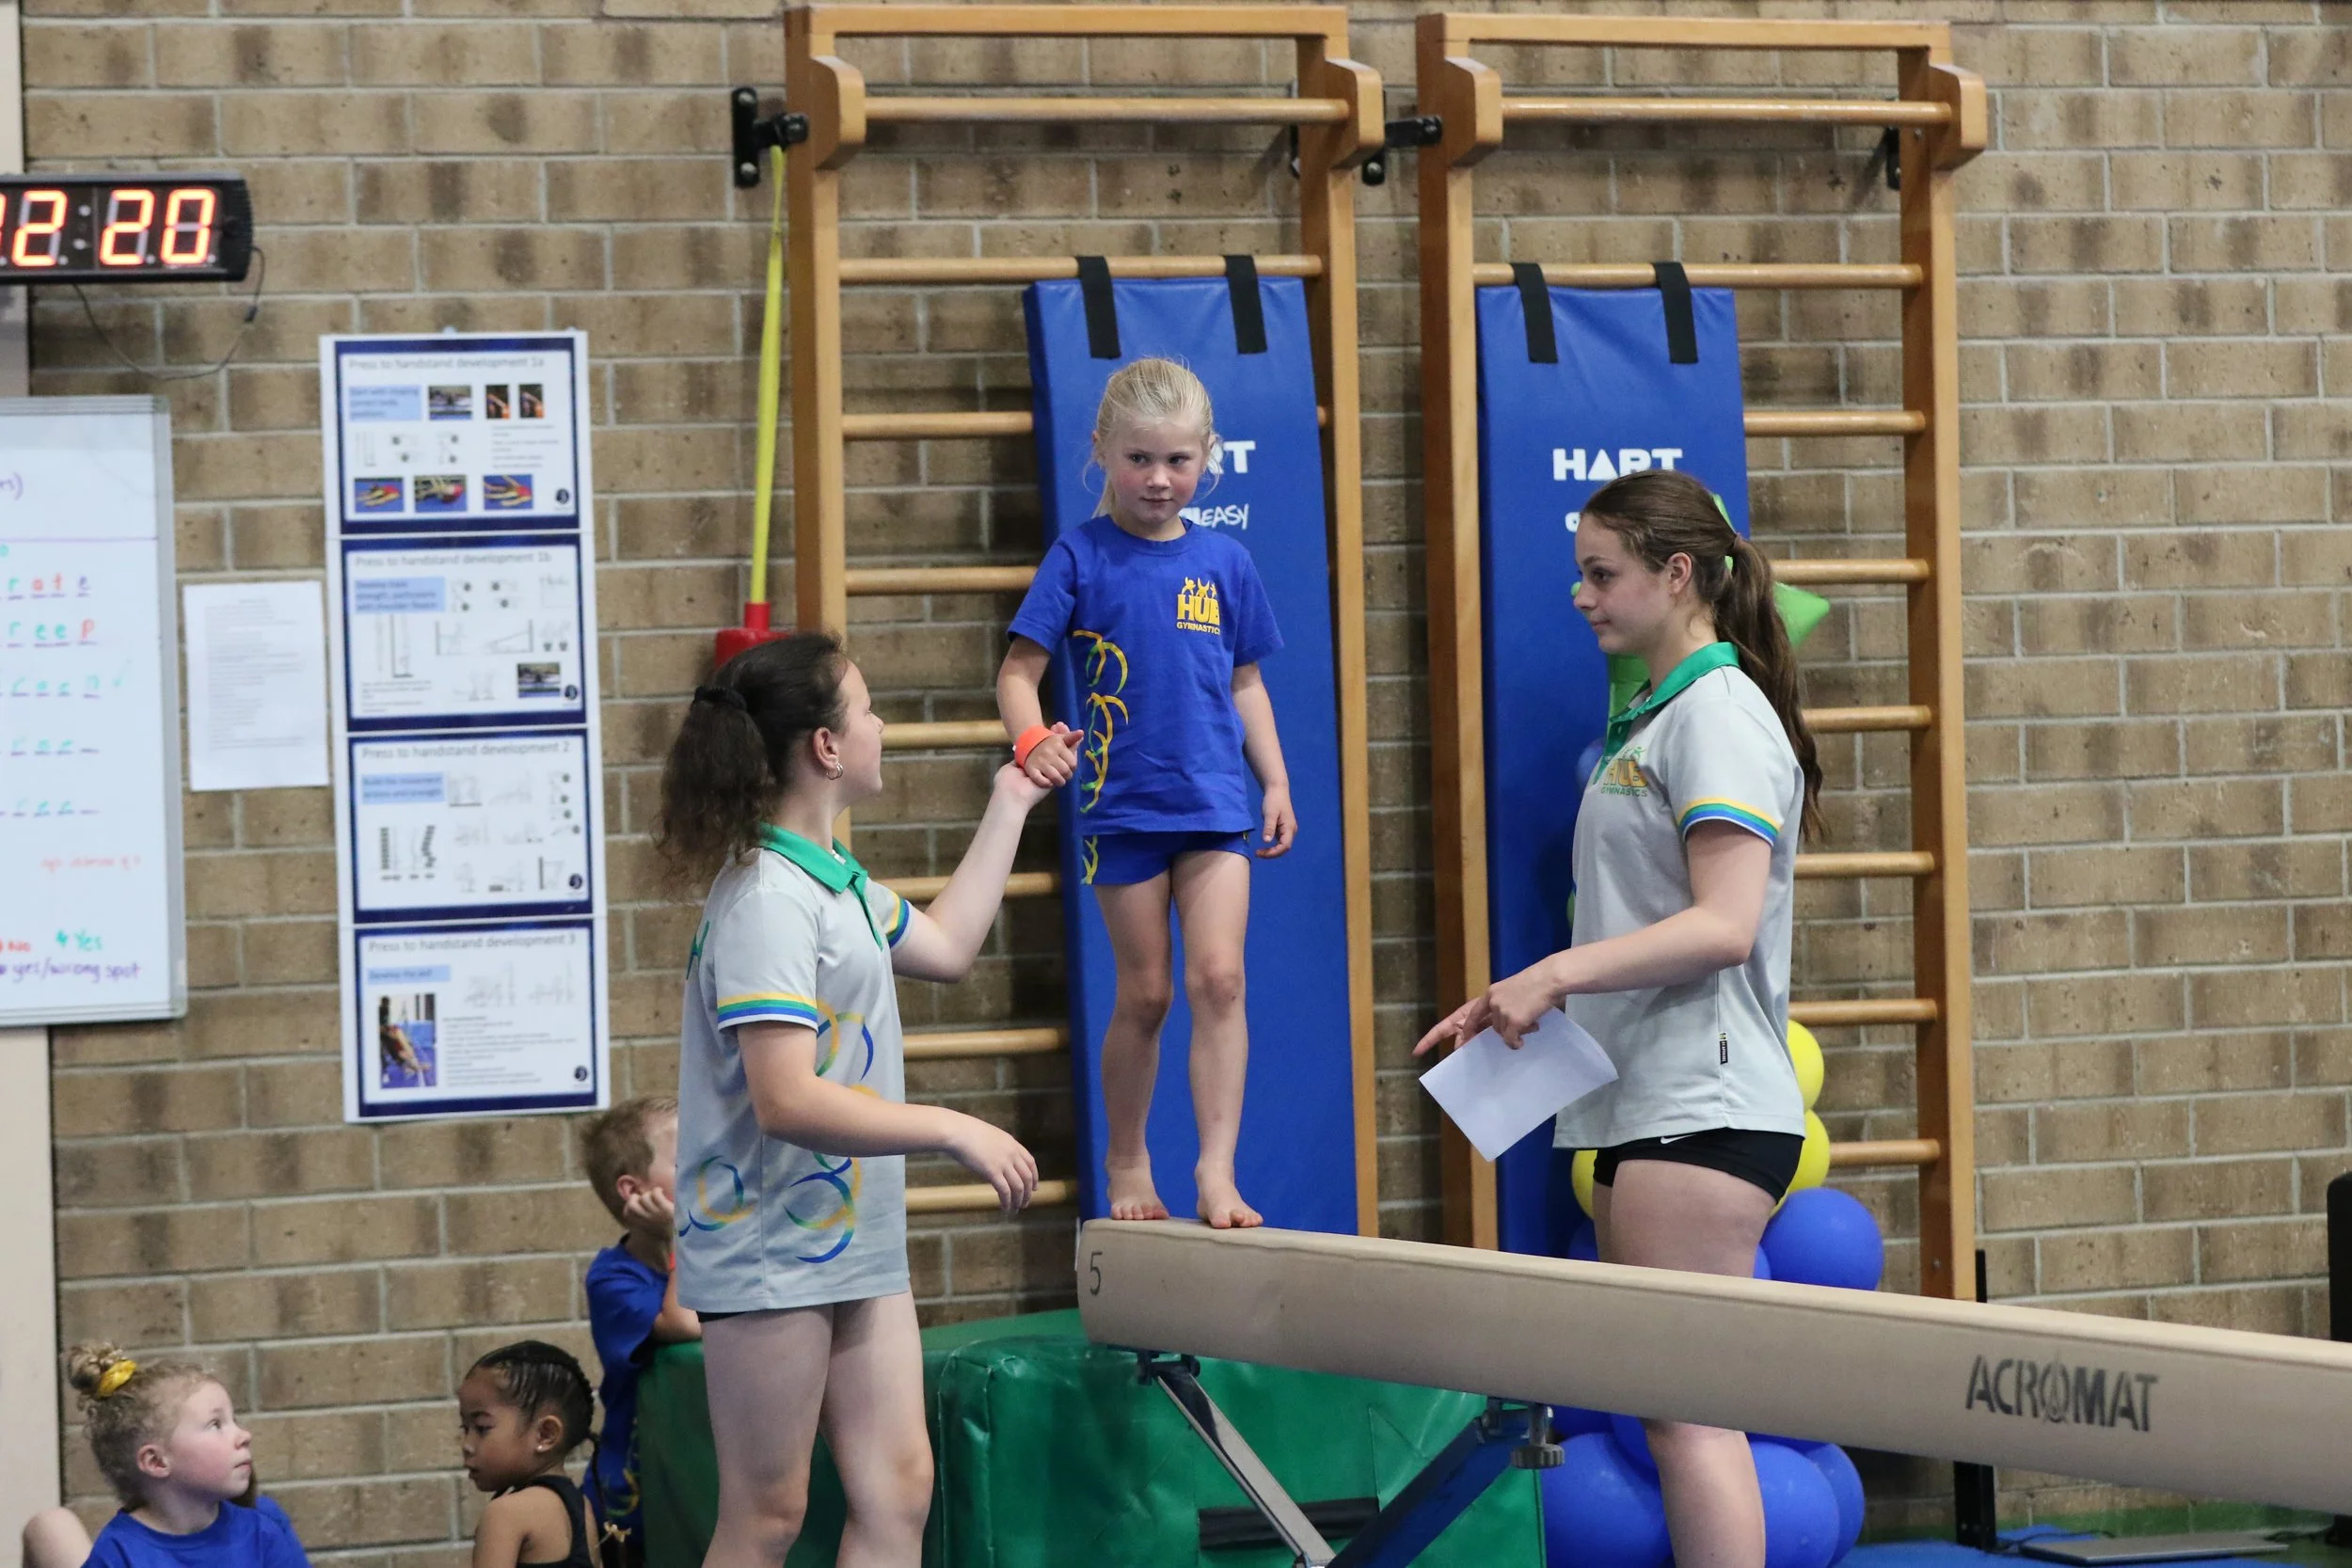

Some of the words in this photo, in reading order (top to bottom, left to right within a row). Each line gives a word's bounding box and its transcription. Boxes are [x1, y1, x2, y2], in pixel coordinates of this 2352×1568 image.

[1552, 448, 1683, 481] HART
[1177, 594, 1220, 626] HUB
[361, 747, 393, 759] Press
[397, 747, 410, 758] to
[412, 743, 478, 758] handstand
[481, 740, 560, 755] development
[1600, 786, 1648, 798] GYMNASICS
[368, 941, 400, 953] Press
[404, 941, 417, 952] to
[420, 937, 483, 950] handstand
[486, 934, 564, 948] development
[1089, 1251, 1103, 1295] 5
[1965, 1353, 2159, 1432] ACROMAT
